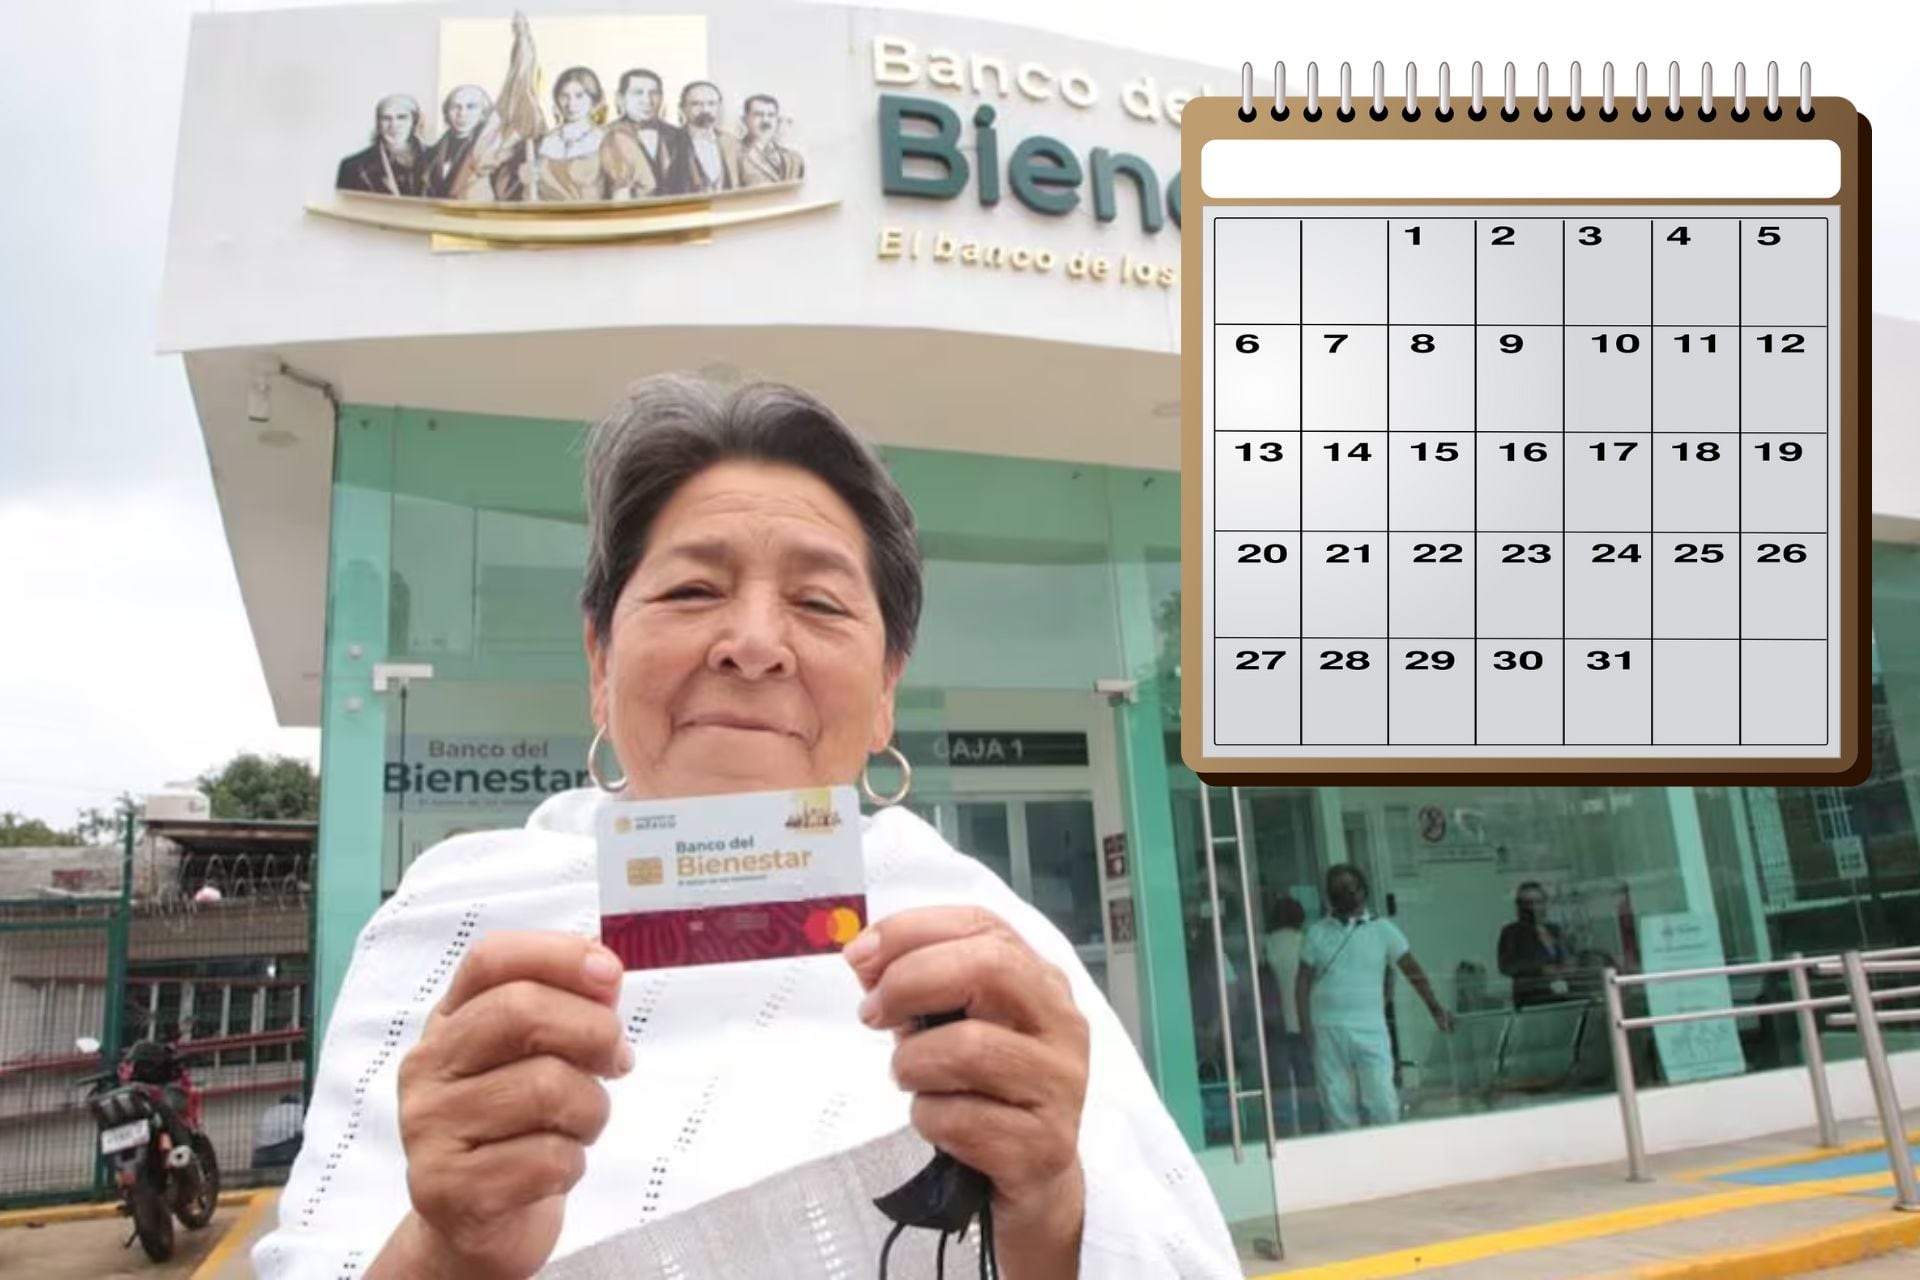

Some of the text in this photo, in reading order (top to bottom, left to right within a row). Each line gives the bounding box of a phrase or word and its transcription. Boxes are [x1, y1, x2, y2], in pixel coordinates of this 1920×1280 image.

[873, 35, 1212, 128] Banco de
[878, 227, 1177, 288] El banco de los
[428, 739, 549, 758] Banco del
[934, 737, 1023, 759] CAJA 1
[383, 761, 592, 794] Bienestar
[675, 834, 754, 854] Banco del
[677, 849, 812, 877] Bienestar
